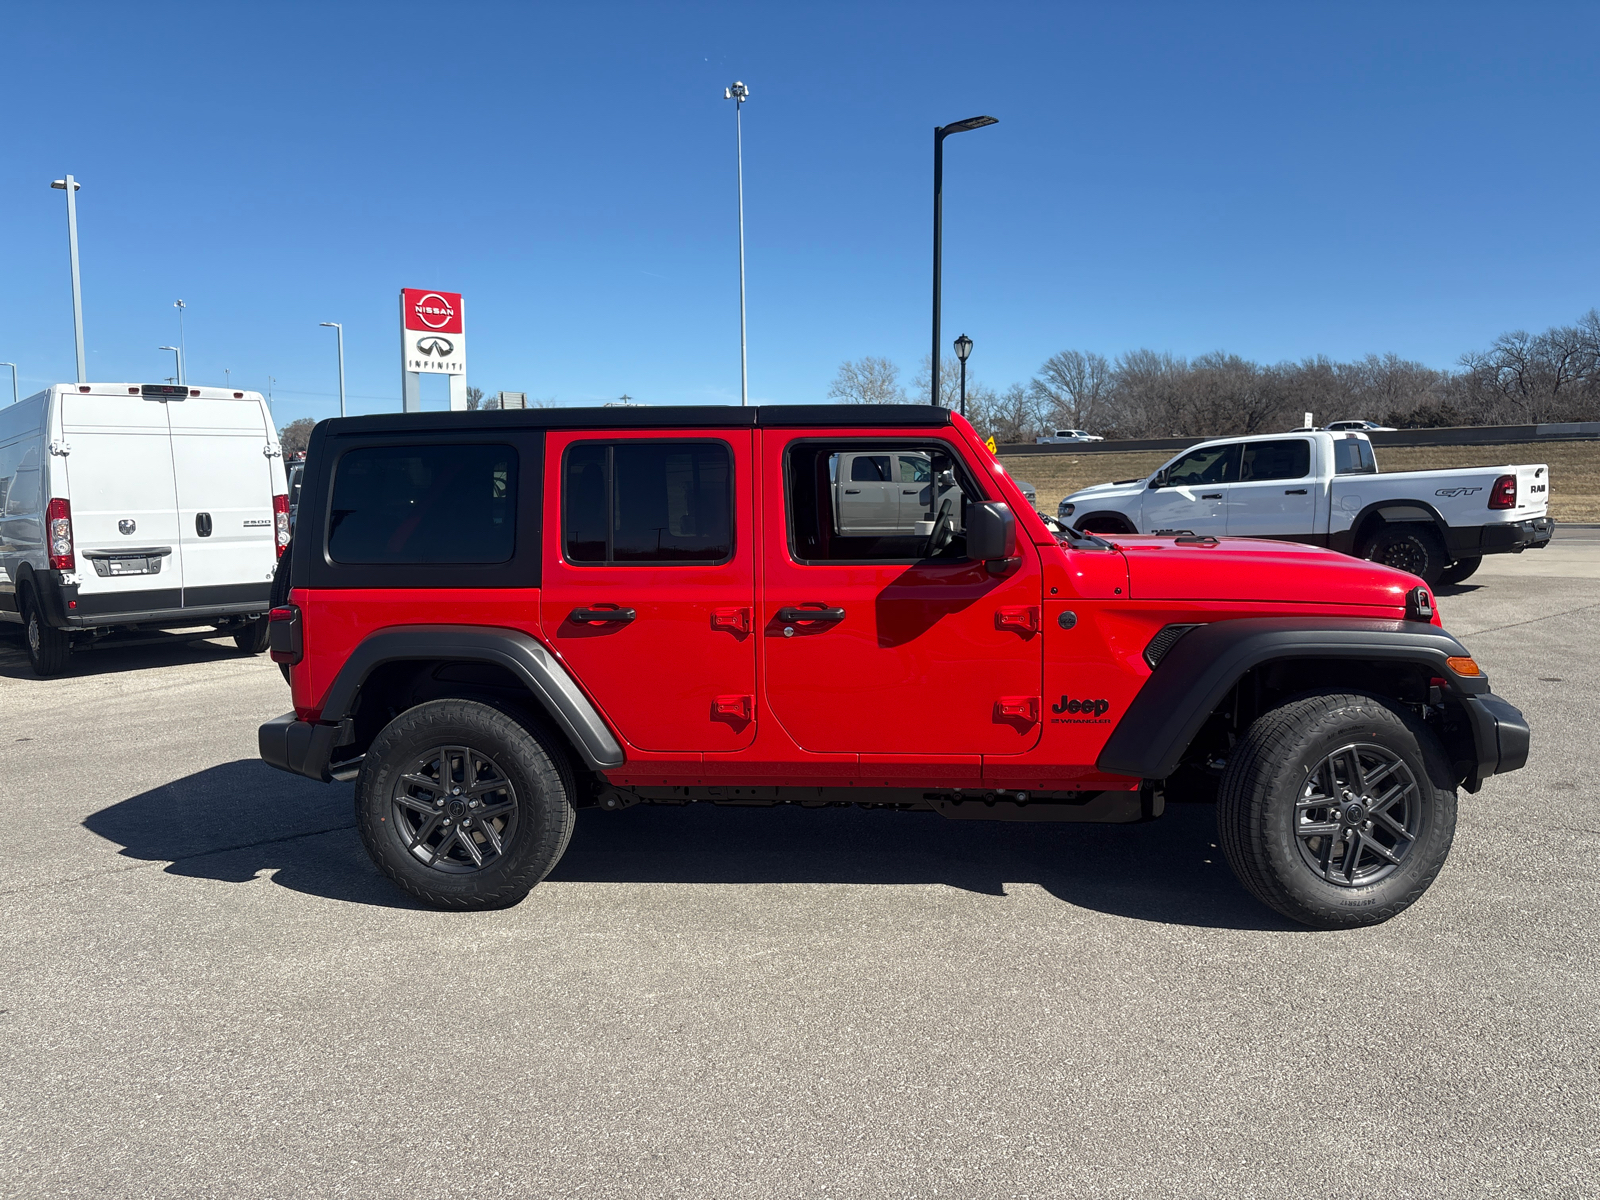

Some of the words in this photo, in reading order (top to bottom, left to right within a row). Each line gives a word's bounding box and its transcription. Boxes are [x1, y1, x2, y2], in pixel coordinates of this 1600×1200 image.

[415, 306, 454, 316] NISSAN
[409, 360, 462, 371] INFINITI
[1530, 484, 1546, 494] RAM
[1052, 694, 1109, 717] Jeep
[1340, 898, 1376, 907] 245/75R17
